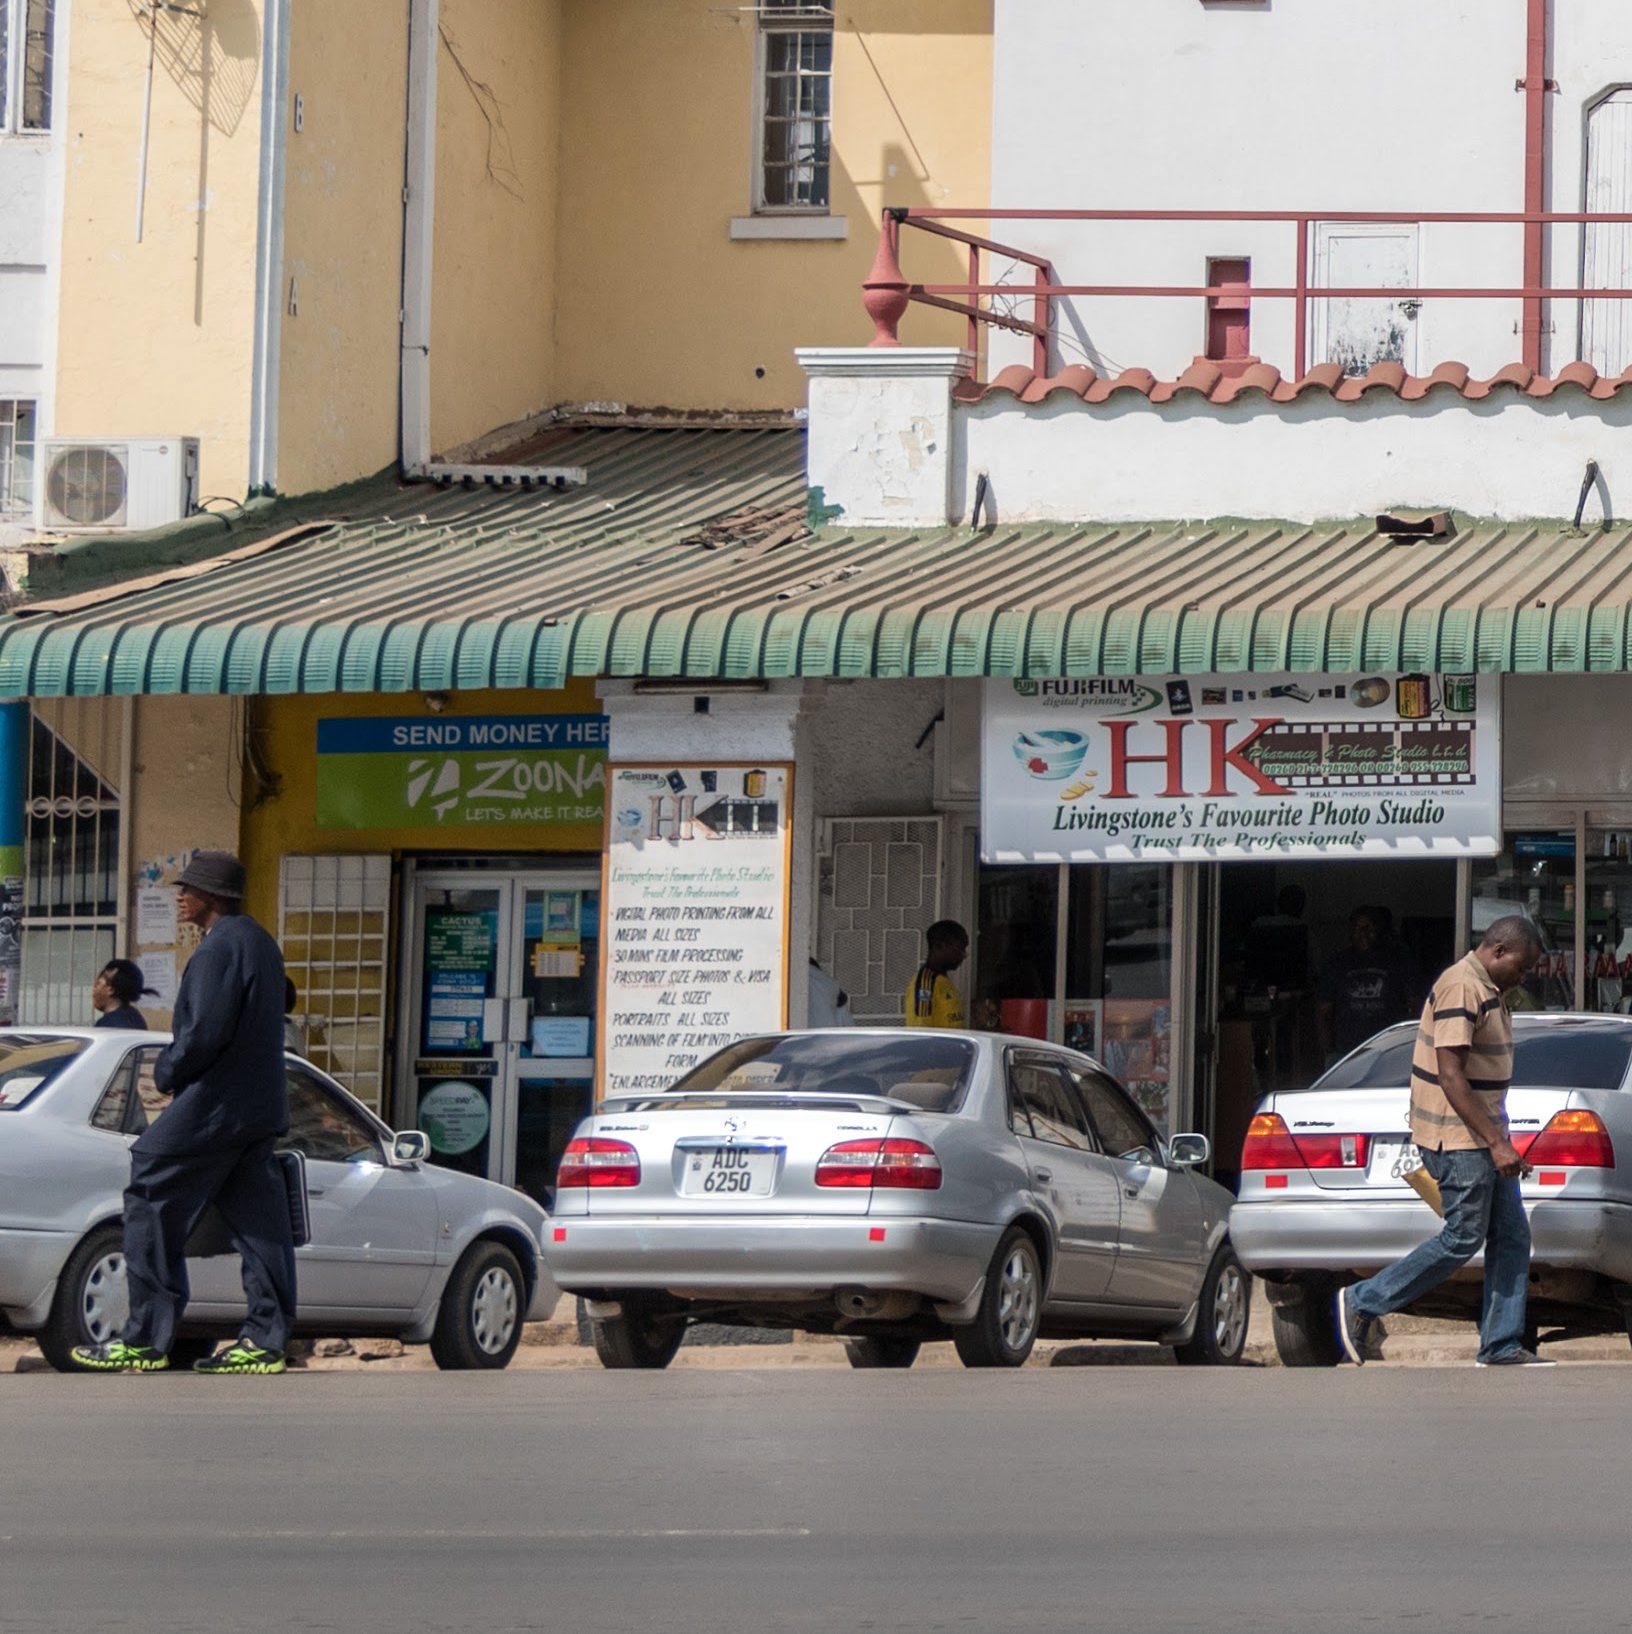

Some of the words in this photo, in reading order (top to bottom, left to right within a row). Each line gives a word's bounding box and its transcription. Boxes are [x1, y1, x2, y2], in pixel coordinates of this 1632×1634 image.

[1042, 679, 1135, 695] FUJIFILM
[1043, 696, 1078, 708] digital
[1081, 696, 1128, 708] printing
[393, 726, 461, 745] SEND
[469, 724, 559, 743] MONEY
[1098, 718, 1297, 798] HK
[1249, 746, 1318, 763] Pharmacy
[1323, 745, 1334, 759] &
[1339, 745, 1376, 758] Photo
[1381, 744, 1428, 758] Studio
[1360, 761, 1375, 774] OR
[466, 754, 606, 799] ZOONA
[466, 806, 505, 821] LET'S
[511, 806, 555, 820] MAKE
[558, 806, 568, 818] IT
[648, 795, 729, 841] HK
[1053, 803, 1193, 837] Livingstone's
[1200, 801, 1303, 828] Favourite
[1309, 799, 1371, 826] Photo
[1377, 798, 1445, 825] Studio
[1132, 833, 1183, 849] Trust
[1190, 833, 1227, 848] The
[1234, 830, 1367, 850] Professionals
[710, 867, 736, 882] Photo
[737, 866, 775, 882] Studio
[669, 886, 683, 898] The
[441, 917, 481, 925] CACTUS
[649, 906, 680, 921] PHOTO
[682, 906, 726, 921] PRINTING
[726, 906, 755, 920] FROM
[755, 906, 774, 920] ALL
[614, 928, 647, 942] MEDIA
[652, 928, 670, 942] ALL
[674, 928, 701, 942] SIZES
[614, 949, 628, 963] 30
[629, 949, 653, 963] MINS
[655, 949, 680, 963] FILM
[681, 948, 743, 963] PROCESSING
[613, 970, 665, 984] PASSPORT
[669, 970, 692, 984] SIZE
[692, 970, 731, 984] PHOTOS
[734, 970, 746, 984] &
[747, 970, 771, 984] VISA
[657, 991, 677, 1005] ALL
[681, 991, 712, 1005] SIZES
[612, 1013, 671, 1027] PORTRAITS
[677, 1013, 696, 1026] ALL
[700, 1012, 730, 1026] SIZES
[614, 1034, 666, 1048] SCANNING
[667, 1034, 682, 1047] OF
[712, 1149, 748, 1169] ADC
[704, 1171, 751, 1192] 6250
